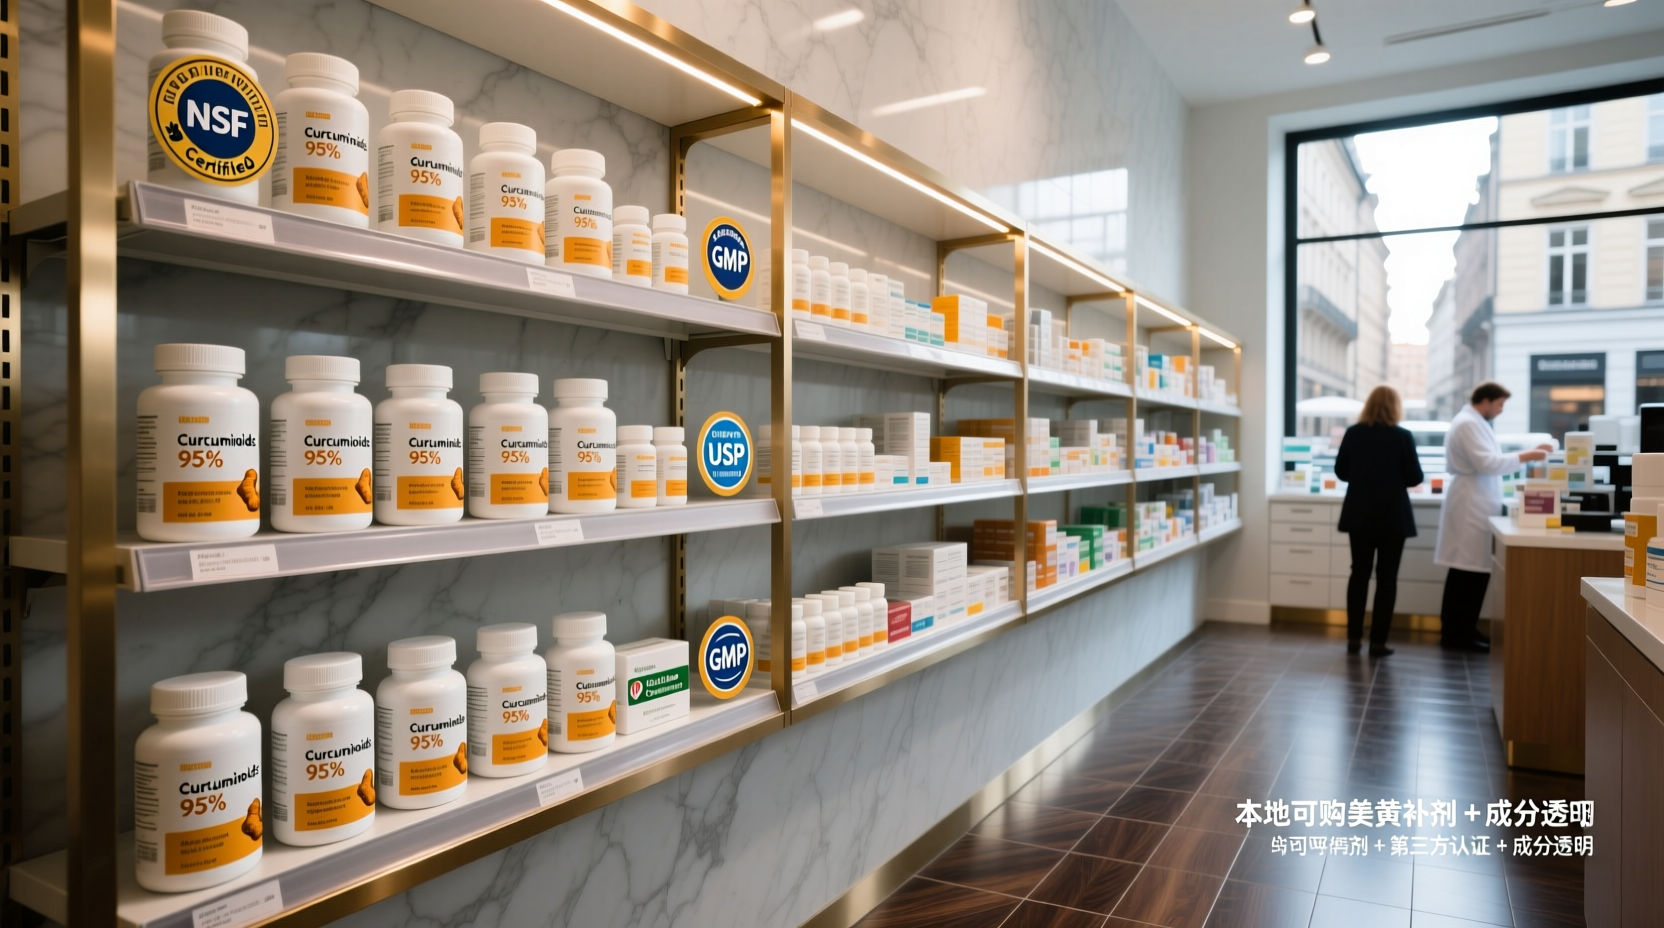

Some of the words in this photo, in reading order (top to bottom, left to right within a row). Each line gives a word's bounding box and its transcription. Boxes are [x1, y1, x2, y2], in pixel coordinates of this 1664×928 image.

[187, 99, 249, 138] NSF
[305, 141, 341, 159] 95%
[410, 169, 442, 186] 95%
[711, 245, 749, 273] GMP
[177, 450, 224, 468] 95%
[304, 450, 343, 466] 95%
[408, 450, 442, 465] 95%
[501, 450, 530, 464] 95%
[708, 442, 746, 467] USP
[709, 643, 747, 671] GMP
[502, 709, 530, 724] 95%
[410, 733, 444, 751] 95%
[306, 761, 346, 781] 95%
[180, 793, 227, 818] 95%
